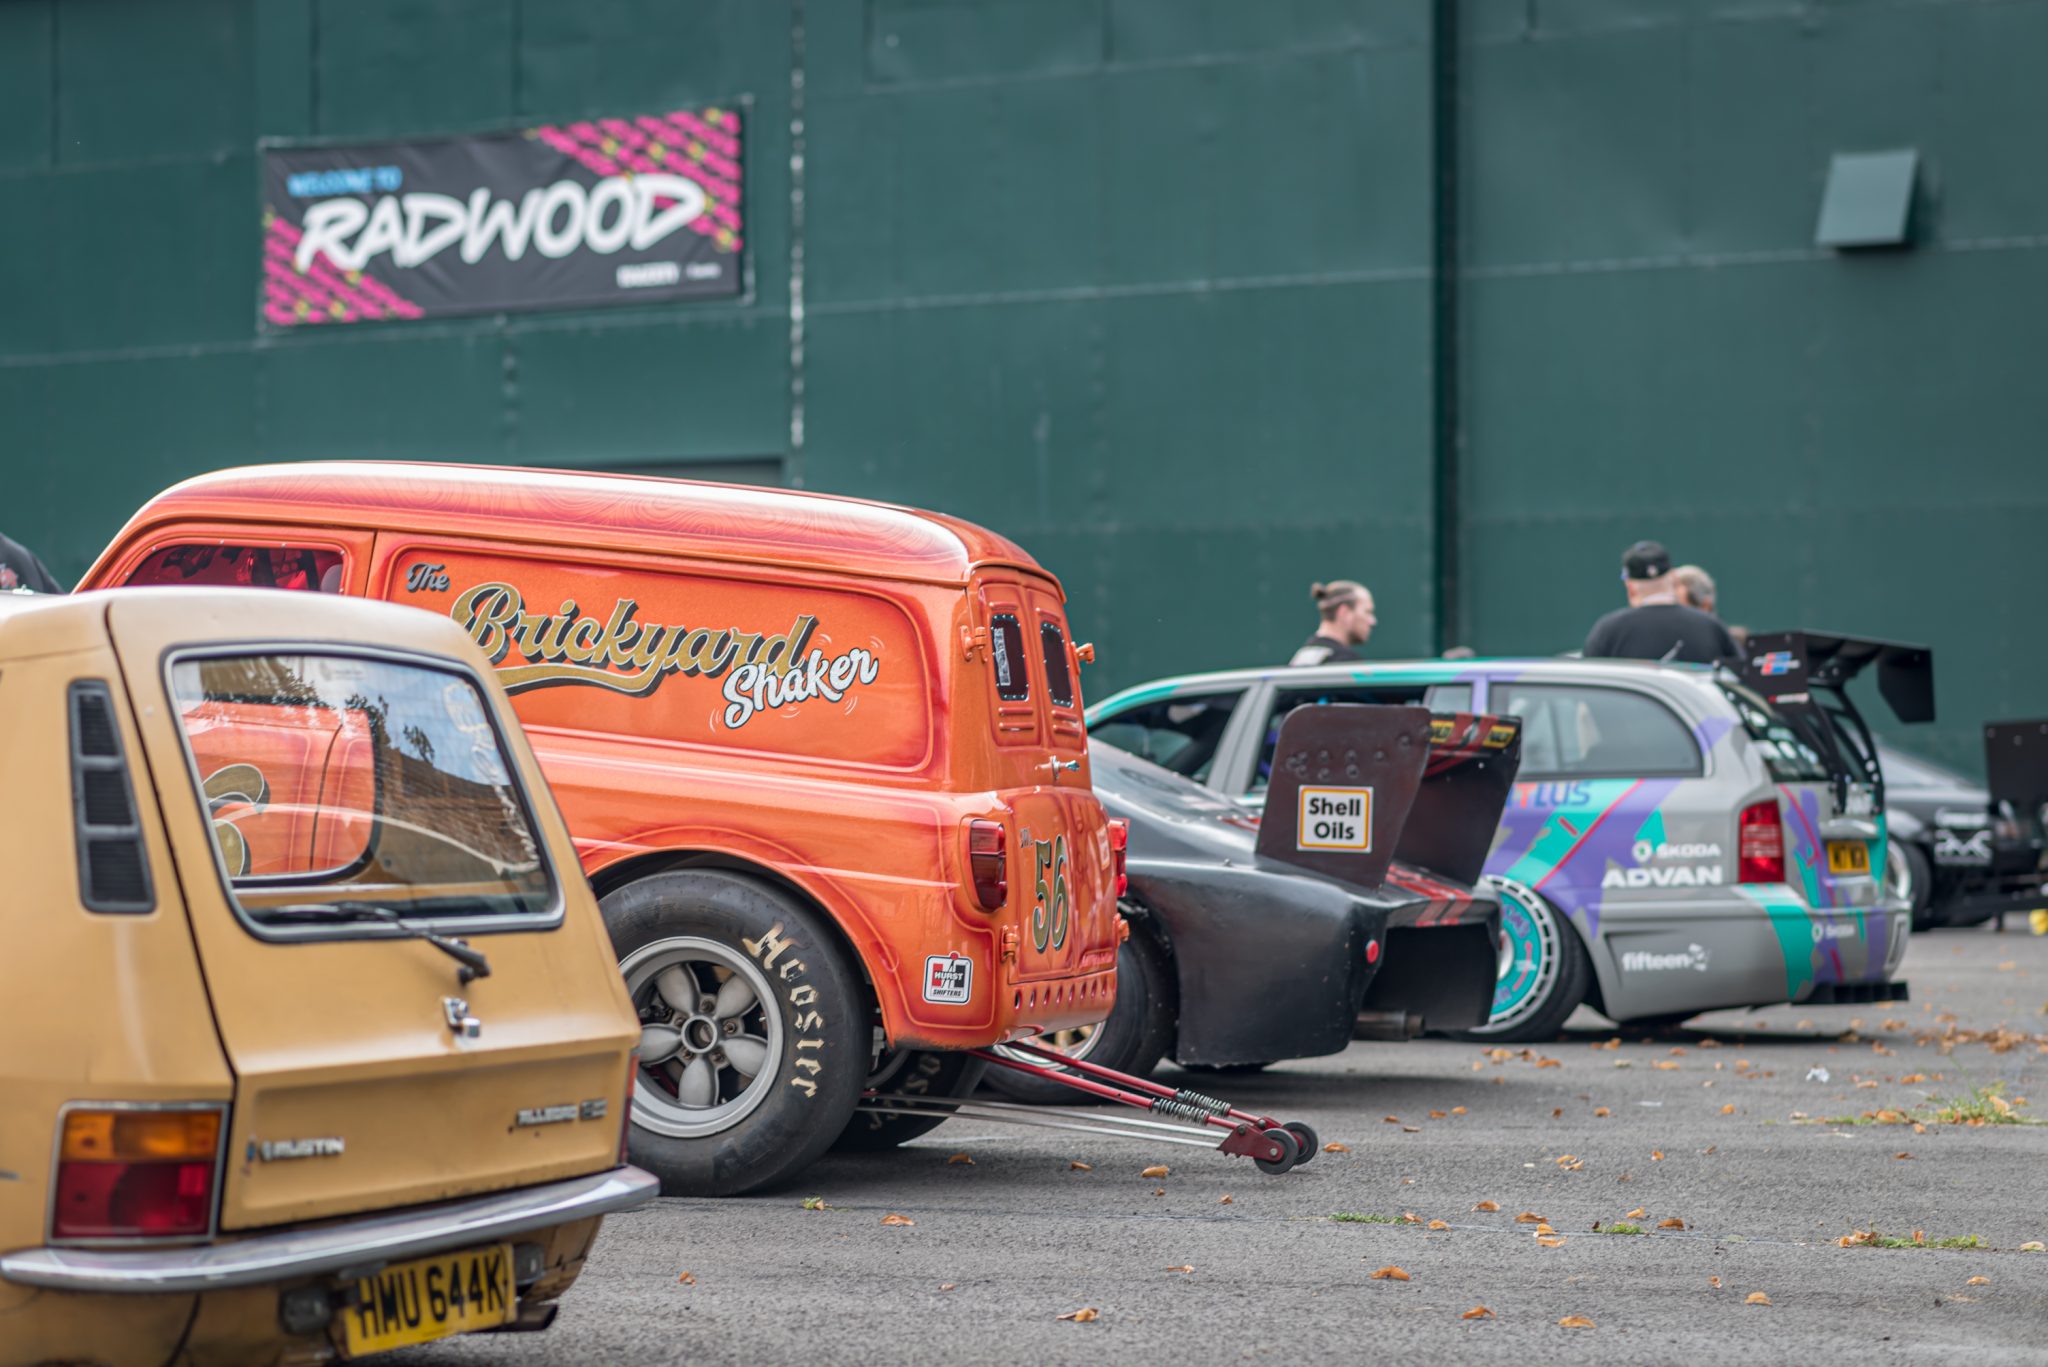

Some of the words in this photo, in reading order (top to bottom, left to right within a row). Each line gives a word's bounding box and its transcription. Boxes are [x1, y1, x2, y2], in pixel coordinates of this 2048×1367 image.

[295, 173, 705, 272] RADWOOD
[406, 563, 450, 592] The
[449, 581, 820, 698] Brickyard
[722, 647, 880, 729] Shaker
[1308, 797, 1361, 817] Shell
[1313, 820, 1355, 840] Oils
[1601, 865, 1724, 888] ADVAN
[1032, 833, 1070, 954] 56
[934, 971, 965, 981] HURST
[932, 989, 963, 997] SHIFTERS
[273, 1136, 345, 1158] AUSTIN
[355, 1269, 421, 1339] HMU
[426, 1252, 505, 1324] 644K
